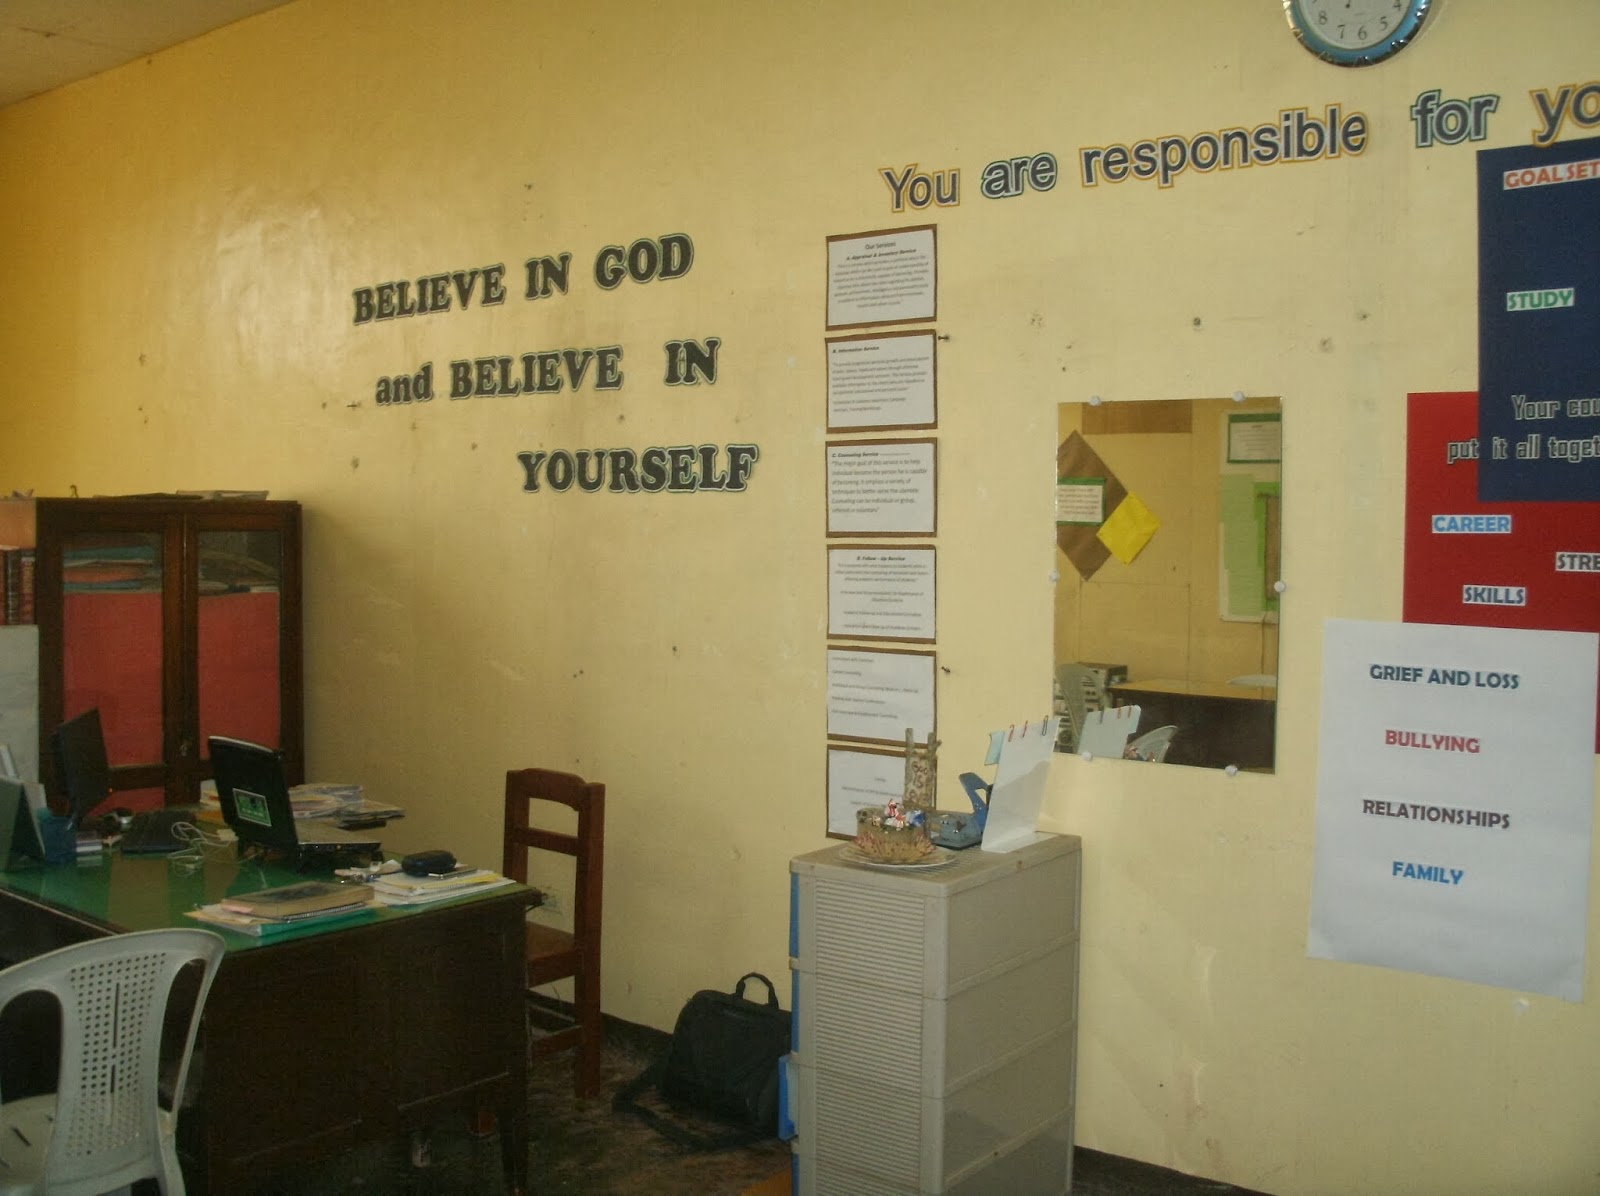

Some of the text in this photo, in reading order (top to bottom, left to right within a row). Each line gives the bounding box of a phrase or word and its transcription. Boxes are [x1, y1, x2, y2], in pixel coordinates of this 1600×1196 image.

[1318, 12, 1328, 25] 8
[1379, 16, 1388, 31] 5
[1337, 24, 1346, 39] 7
[1357, 25, 1367, 40] 6
[878, 81, 1600, 213] You are responsible for yo
[1505, 167, 1564, 188] GOAL
[352, 232, 694, 326] BELIEVE IN GOD
[1507, 290, 1573, 310] STUDY
[375, 336, 721, 405] and BELIEVE IN
[1511, 395, 1561, 420] Your
[1447, 437, 1479, 464] put
[1492, 436, 1508, 459] it
[1516, 434, 1541, 459] all
[517, 443, 760, 493] YOURSELF
[1433, 516, 1511, 533] CAREER
[1556, 553, 1600, 570] STRE
[1464, 586, 1525, 604] SKILLS
[1369, 664, 1520, 690] GRIEF AND LOSS
[1385, 729, 1480, 754] BULLYING
[1362, 799, 1510, 829] RELATIONSHIPS
[1391, 861, 1464, 885] FAMILY
